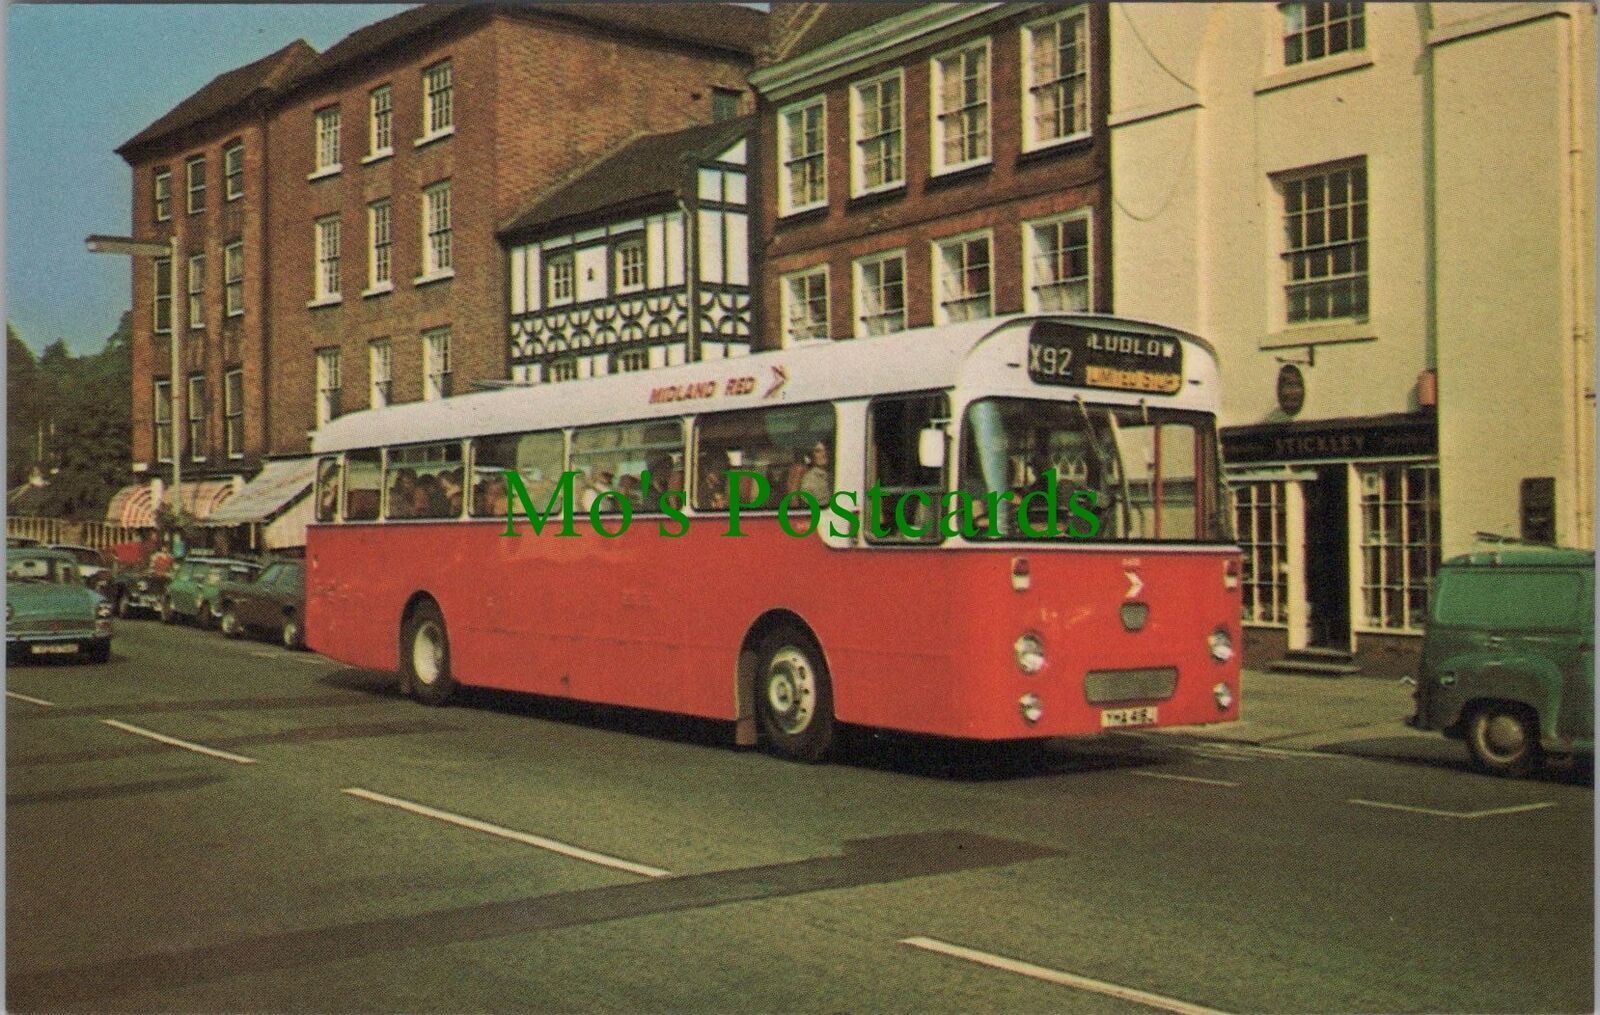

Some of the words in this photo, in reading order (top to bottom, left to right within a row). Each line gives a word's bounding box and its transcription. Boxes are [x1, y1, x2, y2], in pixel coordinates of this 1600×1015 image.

[1031, 343, 1072, 376] X92
[1091, 333, 1174, 358] LUDLOW
[649, 380, 717, 404] MIDLAND
[725, 376, 755, 396] RED
